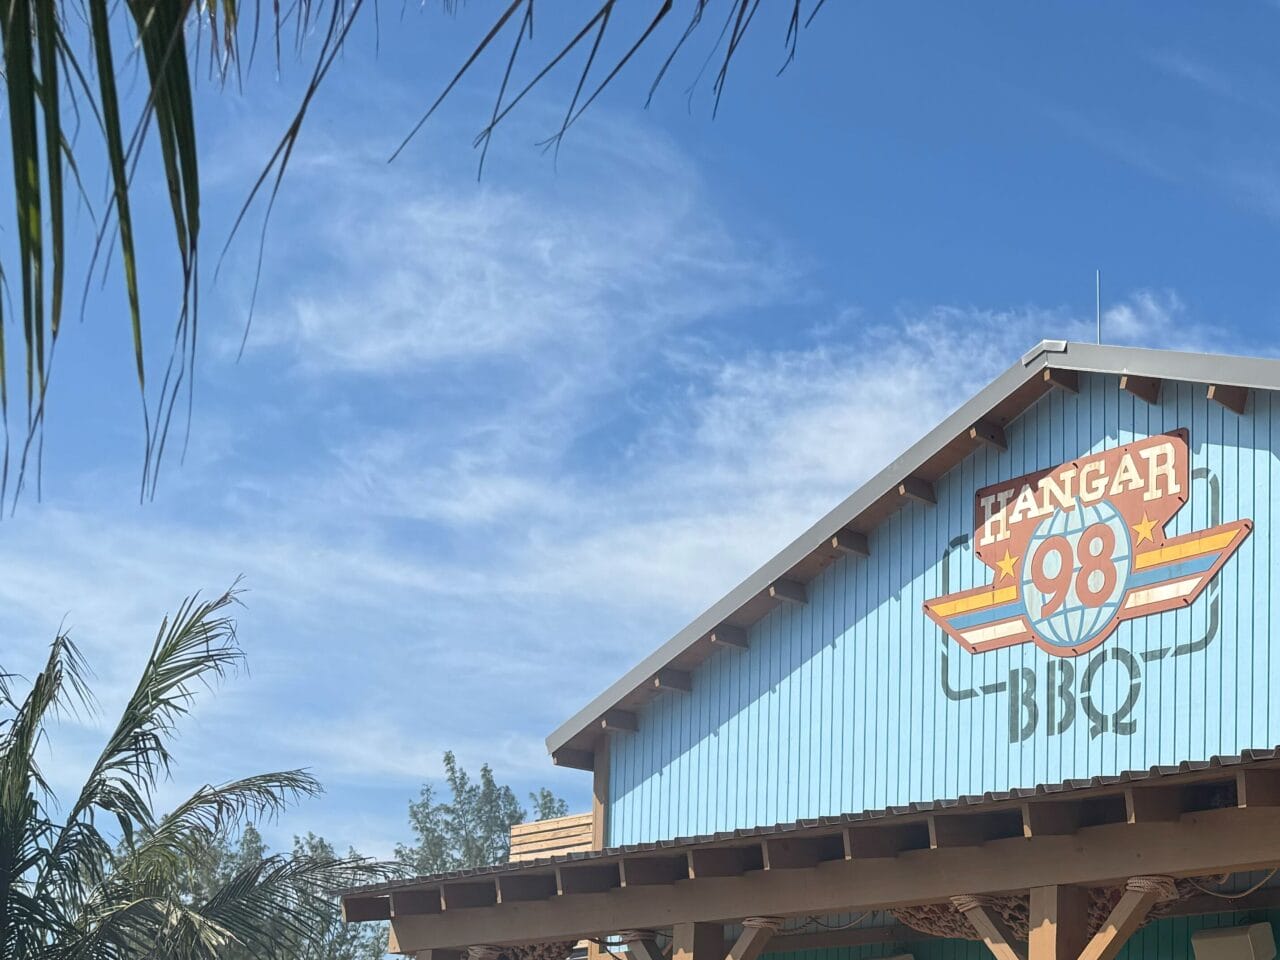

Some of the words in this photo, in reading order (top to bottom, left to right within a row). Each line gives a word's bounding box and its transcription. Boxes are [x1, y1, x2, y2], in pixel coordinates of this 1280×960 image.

[979, 441, 1181, 547] HANGAR
[1030, 521, 1118, 619] 98
[1008, 647, 1142, 745] BBQ
